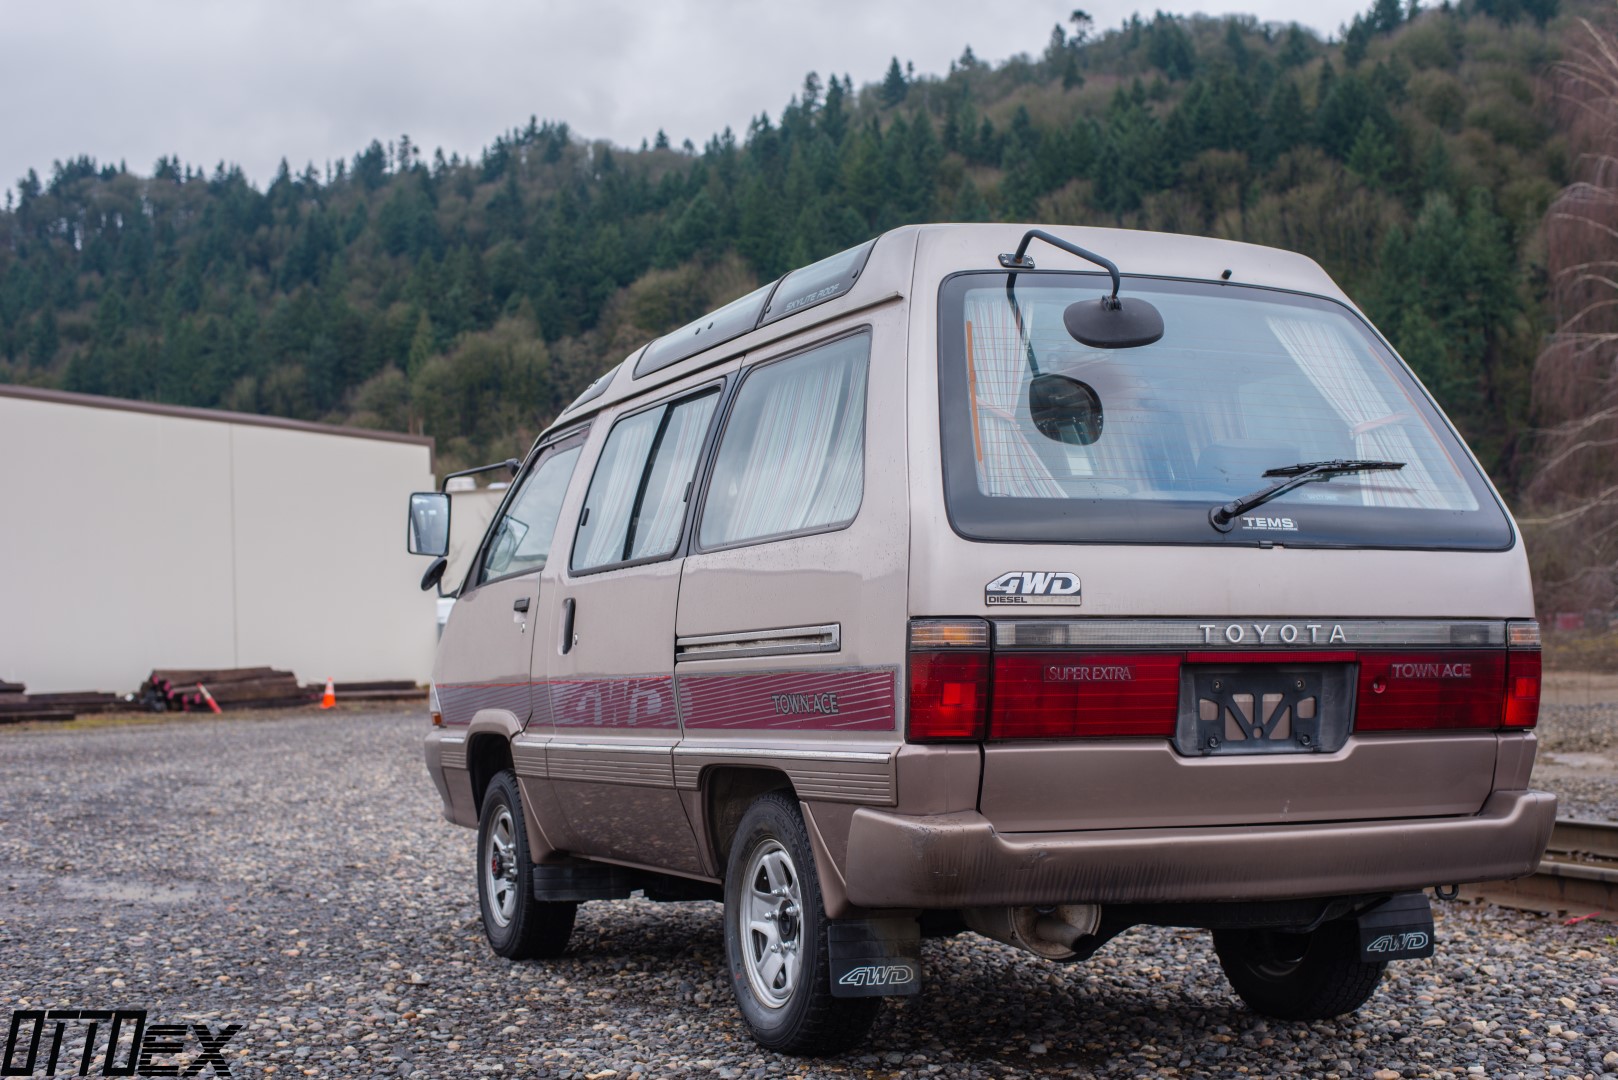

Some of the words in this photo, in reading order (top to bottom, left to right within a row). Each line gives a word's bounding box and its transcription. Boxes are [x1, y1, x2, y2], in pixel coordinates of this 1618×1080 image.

[785, 292, 818, 311] SKYLITE
[816, 283, 840, 298] ROOF
[1242, 517, 1294, 528] TEMS
[986, 571, 1081, 594] 4WD
[988, 596, 1027, 604] DIESEL
[1199, 624, 1347, 644] TOYOTA
[1049, 666, 1091, 681] SUPER
[1092, 666, 1132, 681] EXTRA
[1391, 663, 1439, 678] TOWN
[1441, 663, 1472, 678] ACE
[771, 693, 810, 714] TOWN
[812, 693, 839, 714] ACE
[1366, 931, 1429, 953] 4WD
[838, 965, 914, 986] 4WD
